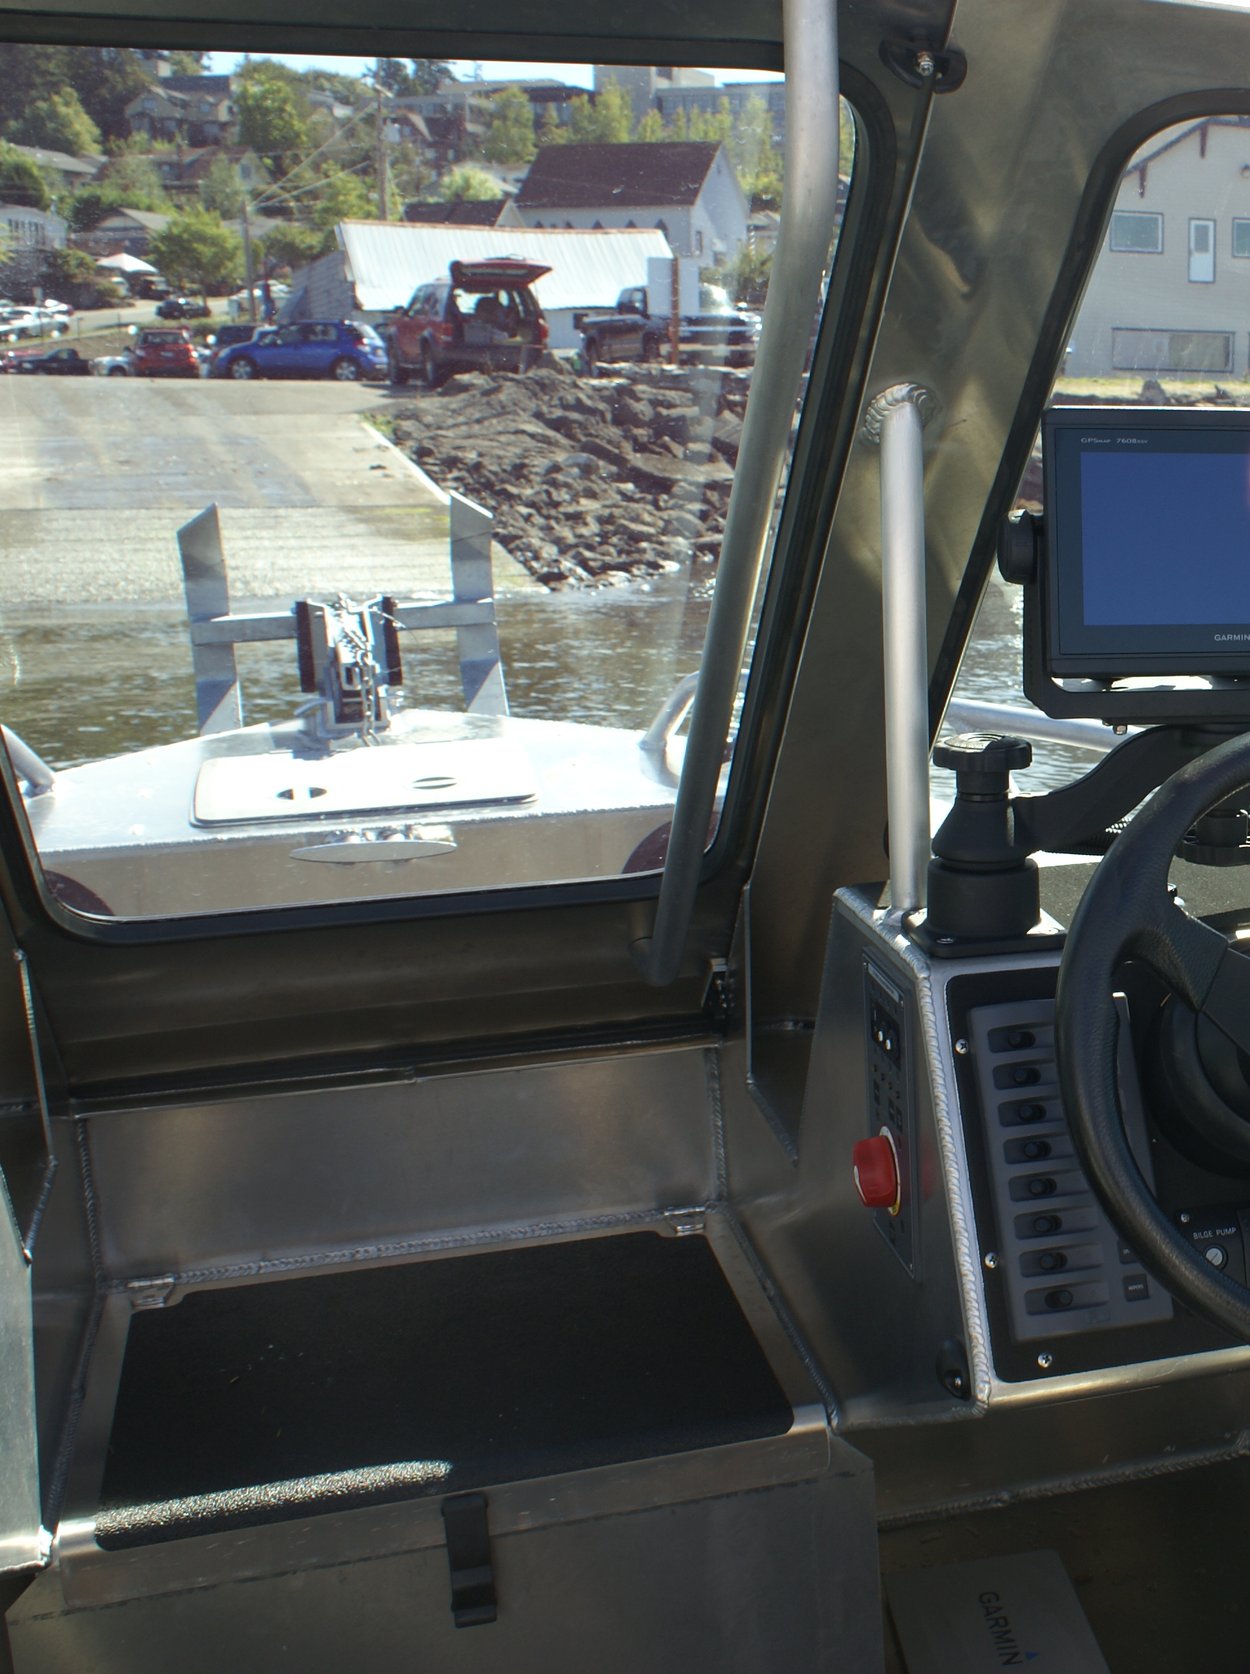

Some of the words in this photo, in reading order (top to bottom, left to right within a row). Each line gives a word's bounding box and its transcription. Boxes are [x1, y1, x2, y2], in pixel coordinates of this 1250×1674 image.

[1214, 633, 1250, 642] GARMIN
[1193, 1230, 1213, 1240] BILGE
[1216, 1226, 1237, 1236] PUMP
[978, 1591, 1024, 1666] GARMIN
